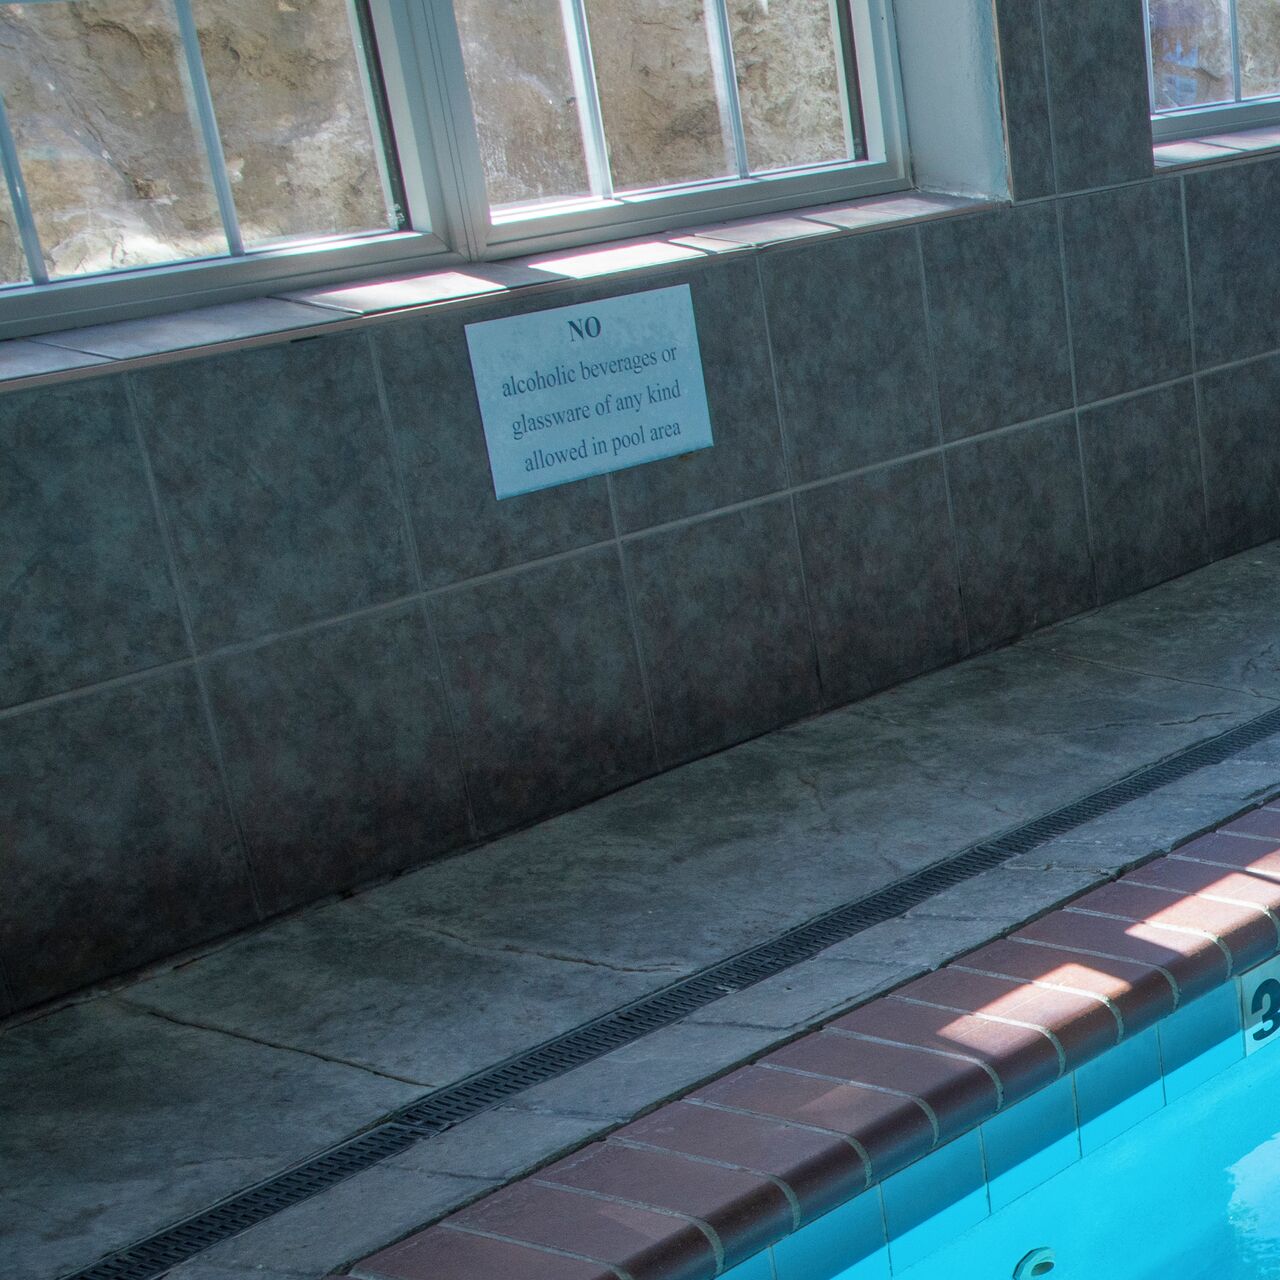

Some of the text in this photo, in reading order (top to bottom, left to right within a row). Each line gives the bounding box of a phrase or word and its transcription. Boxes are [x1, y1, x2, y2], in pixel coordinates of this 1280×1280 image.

[568, 316, 602, 342] NO
[502, 346, 678, 398] alcoholic beverages or
[512, 379, 682, 441] glassware of any kind
[524, 422, 682, 473] allowed in pool area
